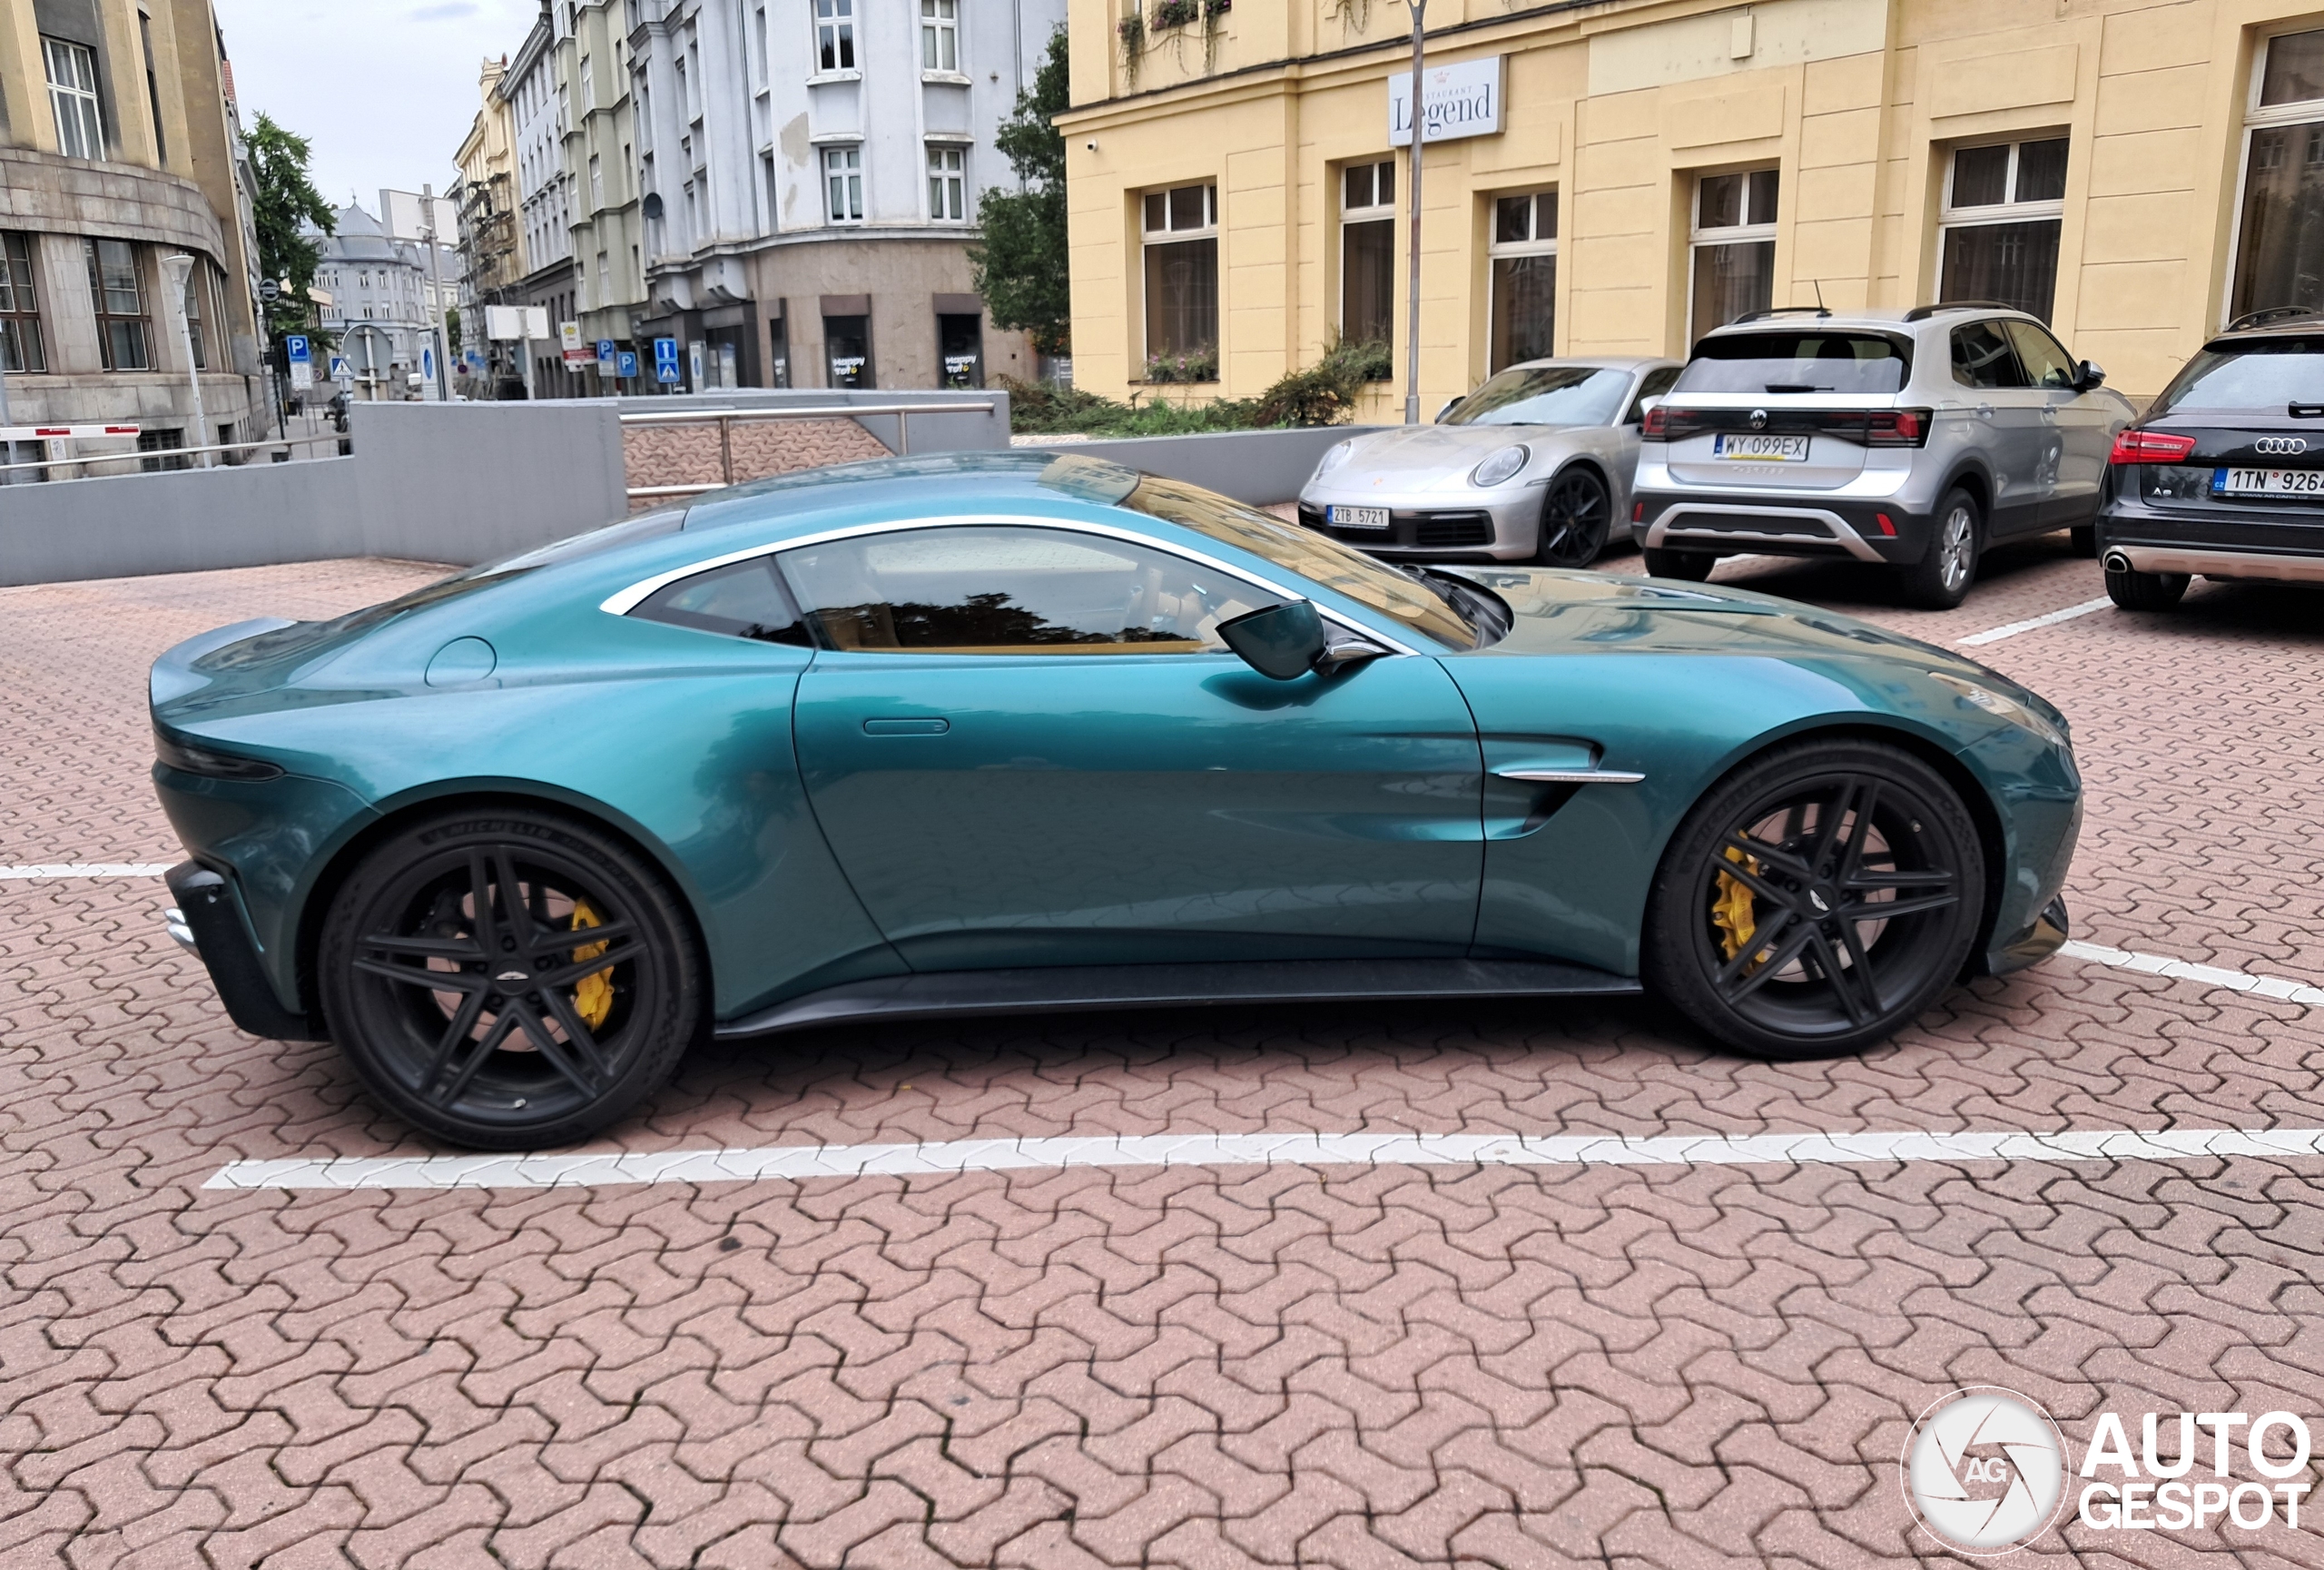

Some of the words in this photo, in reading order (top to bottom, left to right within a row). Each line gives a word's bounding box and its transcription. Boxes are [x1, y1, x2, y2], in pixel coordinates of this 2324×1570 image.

[291, 339, 303, 355] P
[600, 342, 611, 354] P
[621, 355, 633, 370] P
[1726, 438, 1748, 454] WY
[1751, 437, 1805, 456] 099EX
[2232, 470, 2268, 489] 1TN
[1334, 509, 1352, 522] 2TB
[1359, 509, 1384, 524] 5721
[448, 821, 554, 840] MICHELIN
